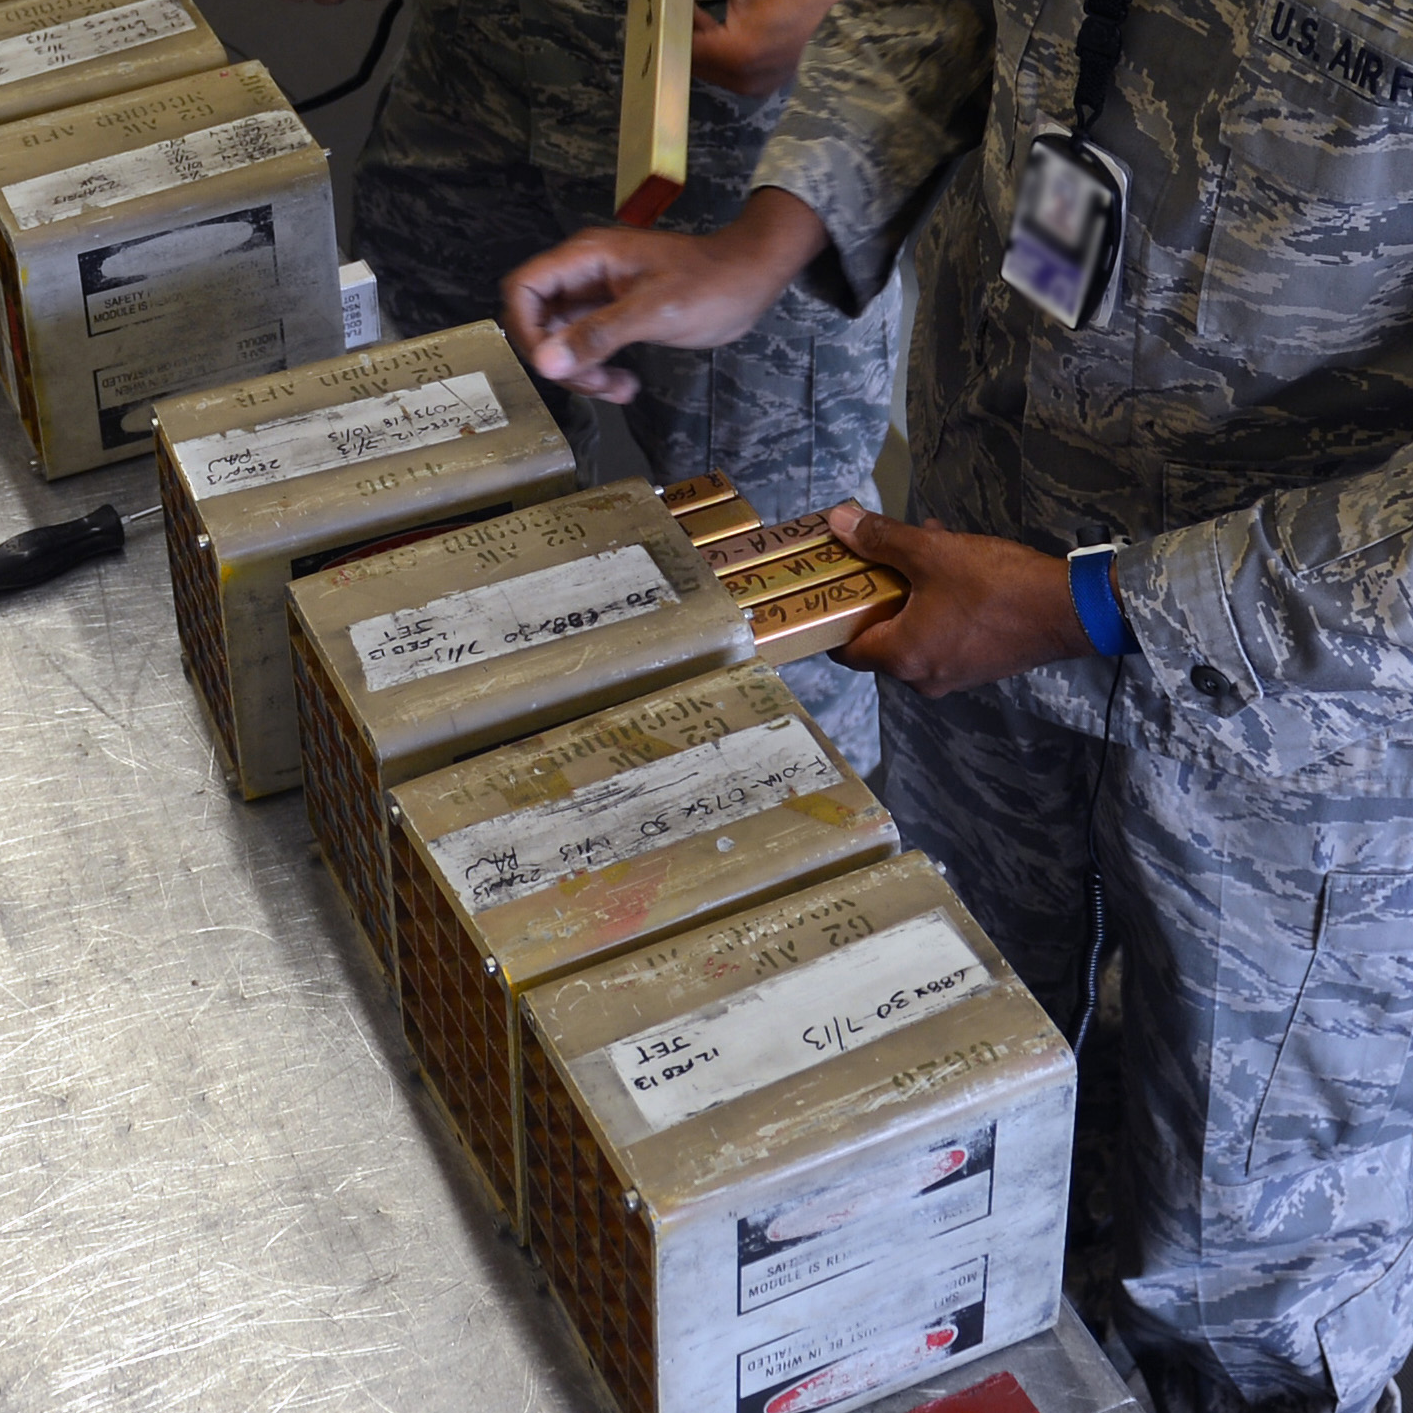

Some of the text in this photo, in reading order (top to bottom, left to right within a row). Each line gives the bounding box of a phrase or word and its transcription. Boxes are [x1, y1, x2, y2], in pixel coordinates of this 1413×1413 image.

[1269, 0, 1321, 64] U.S.
[1328, 39, 1384, 97] AIR
[22, 91, 204, 147] MCCORD AFB
[123, 118, 157, 137] AW
[104, 290, 144, 309] SAFETY
[344, 293, 360, 304] LOT
[93, 301, 148, 323] MODULE IS
[235, 344, 443, 408] MCCORD AFB
[378, 618, 433, 646] JET
[636, 1036, 691, 1065] JET
[662, 1058, 694, 1080] FEB
[634, 1076, 658, 1090] 13
[748, 1262, 820, 1298] MODULE IS
[809, 1348, 821, 1360] IN
[761, 1355, 802, 1377] WHEN
